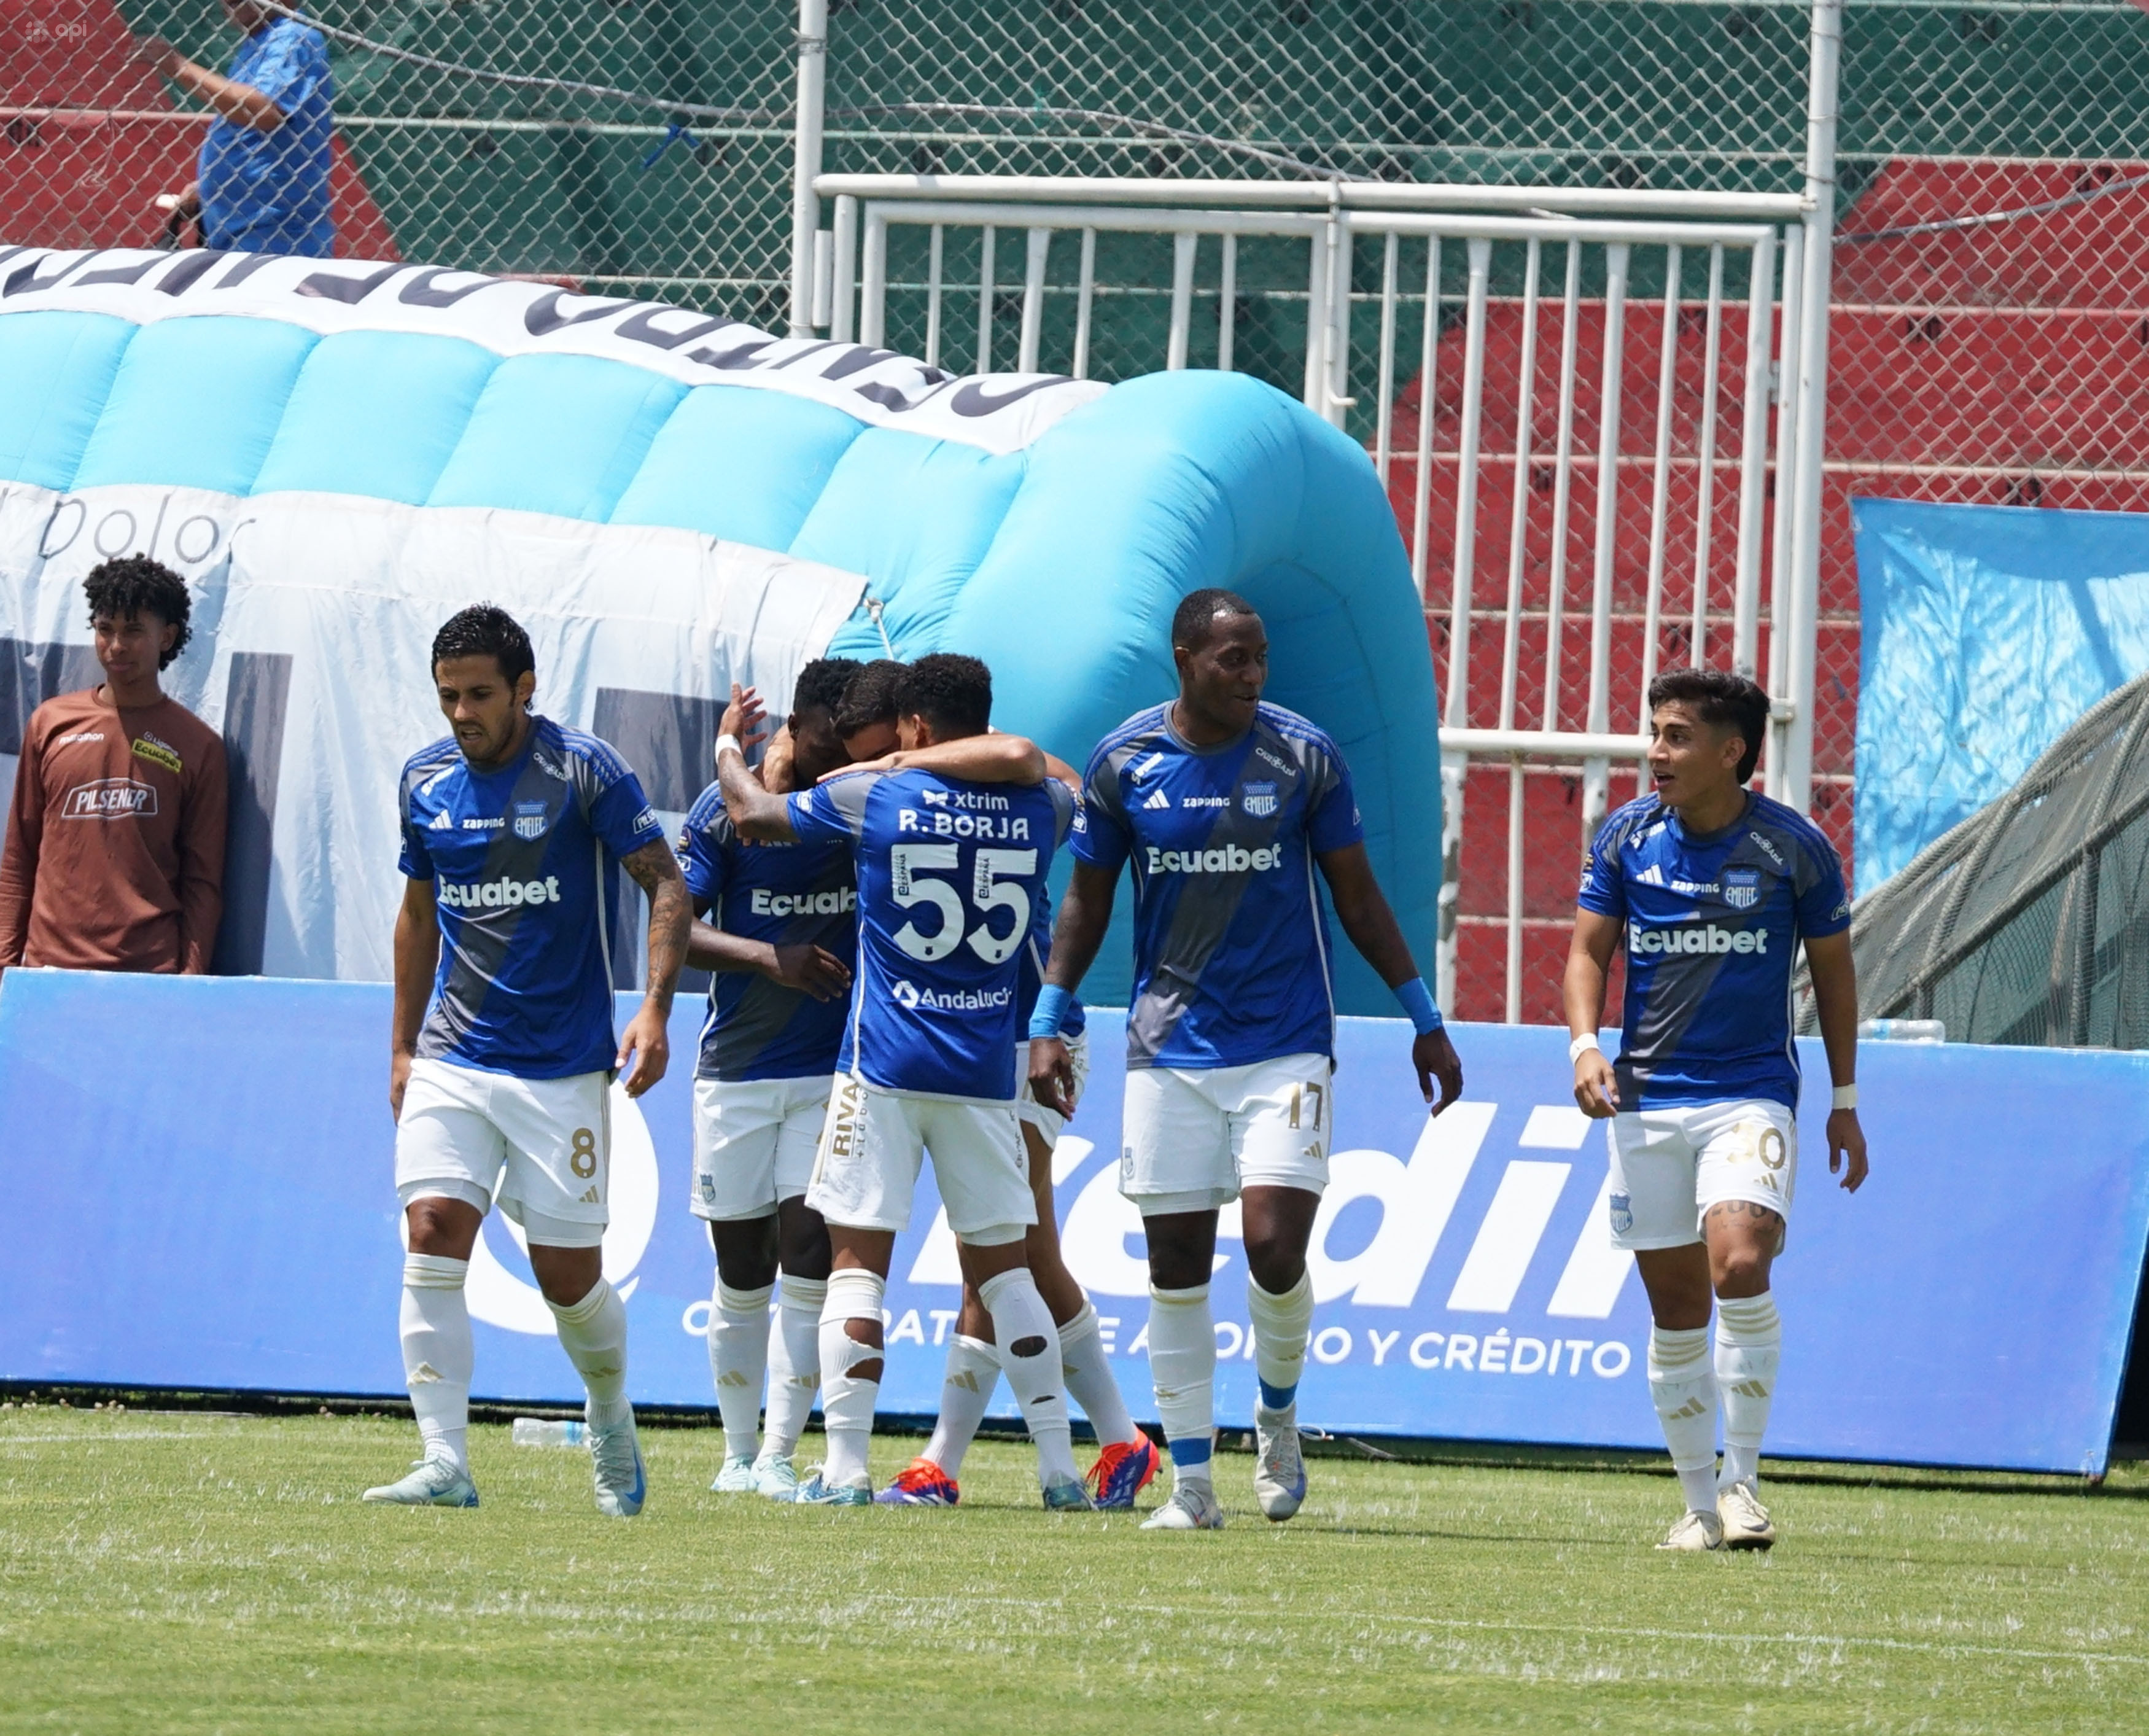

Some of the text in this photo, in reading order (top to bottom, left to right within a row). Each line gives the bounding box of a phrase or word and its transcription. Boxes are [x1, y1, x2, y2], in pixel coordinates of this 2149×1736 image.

[954, 792, 1009, 810] xtrim
[1244, 796, 1278, 815] EMELEC
[515, 816, 546, 838] EMELEC
[1146, 843, 1282, 874] Ecuabet
[438, 874, 561, 908] Ecuabet
[891, 843, 1038, 965] 55
[1725, 886, 1758, 908] EMELEC
[1630, 922, 1769, 955] Ecuabet
[1288, 1081, 1323, 1132] 17
[570, 1127, 597, 1179] 8
[1727, 1123, 1786, 1170] 30
[1369, 1329, 1401, 1366] Y
[1410, 1327, 1631, 1379] CRÉDITO
